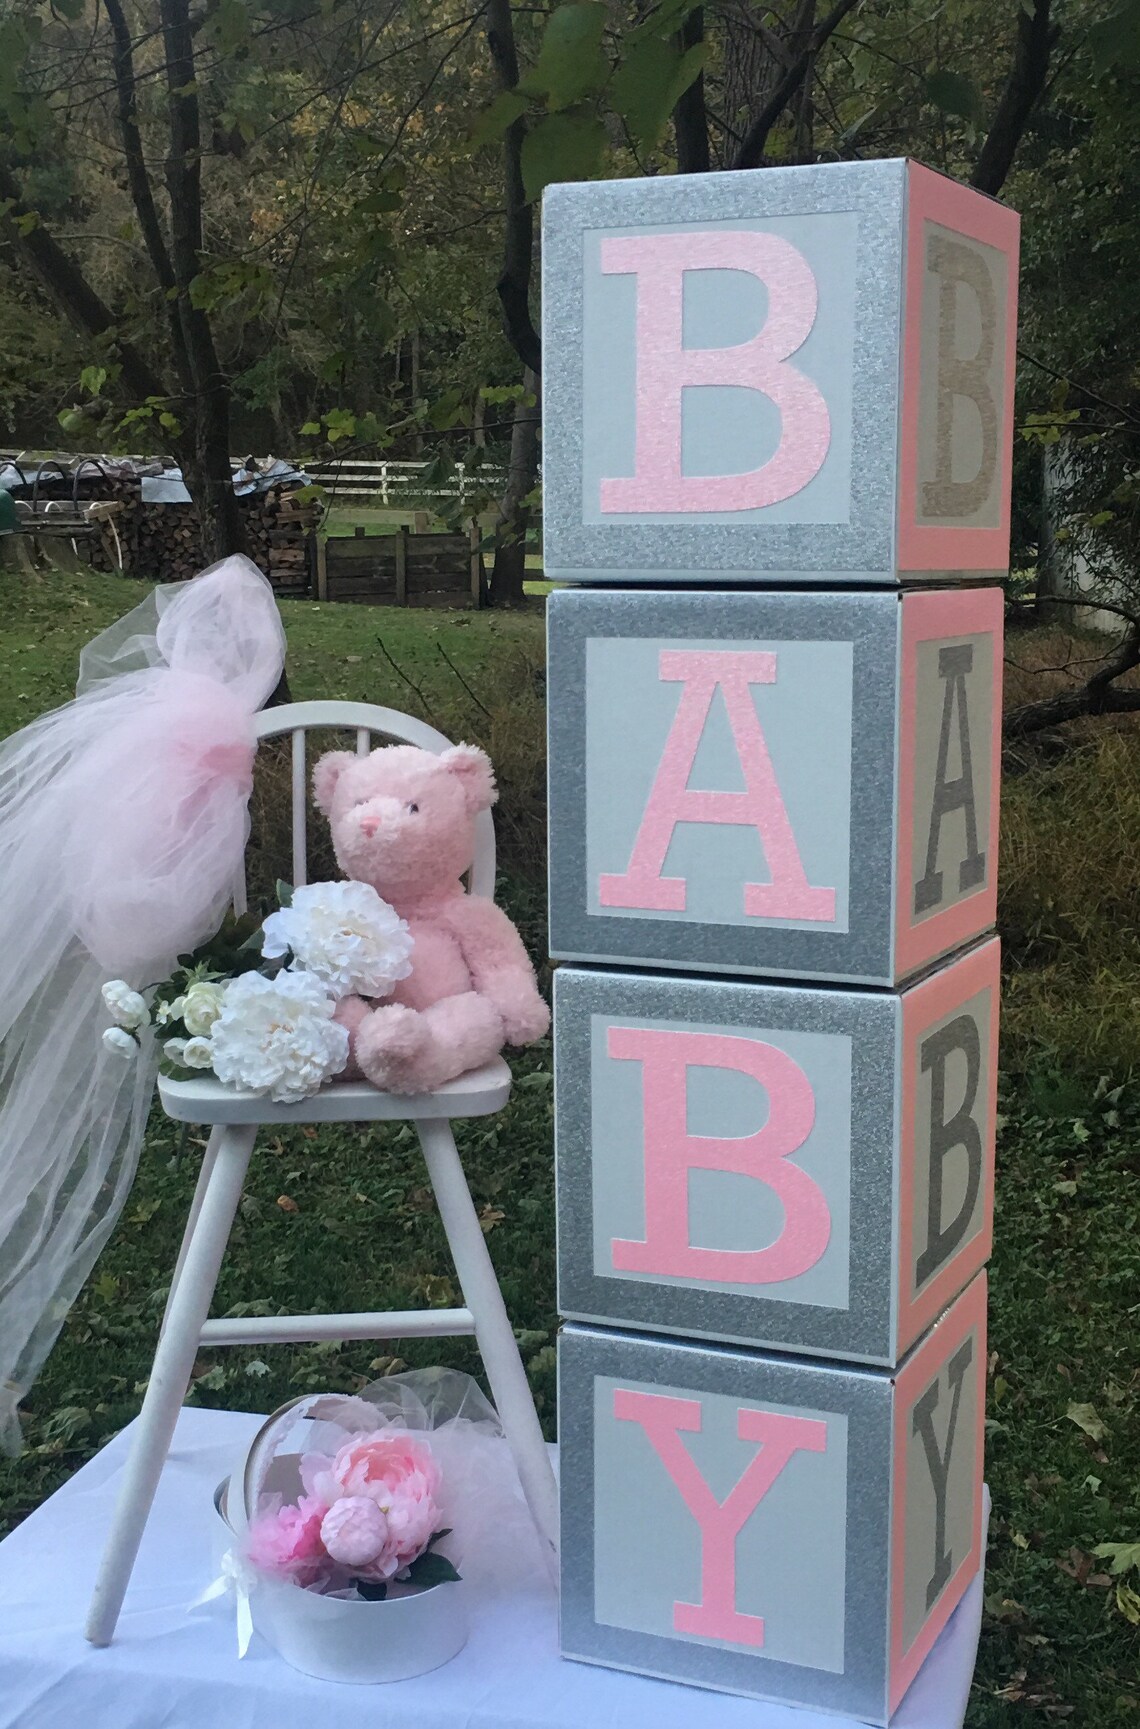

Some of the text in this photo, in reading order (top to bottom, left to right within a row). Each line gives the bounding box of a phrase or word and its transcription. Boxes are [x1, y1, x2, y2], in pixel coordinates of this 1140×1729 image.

[600, 230, 831, 514] B
[921, 235, 998, 517] B
[599, 649, 836, 922] A
[915, 643, 986, 915] A
[607, 1026, 831, 1285] B
[915, 1014, 982, 1289] B
[613, 1388, 827, 1647] Y
[912, 1335, 972, 1612] Y
